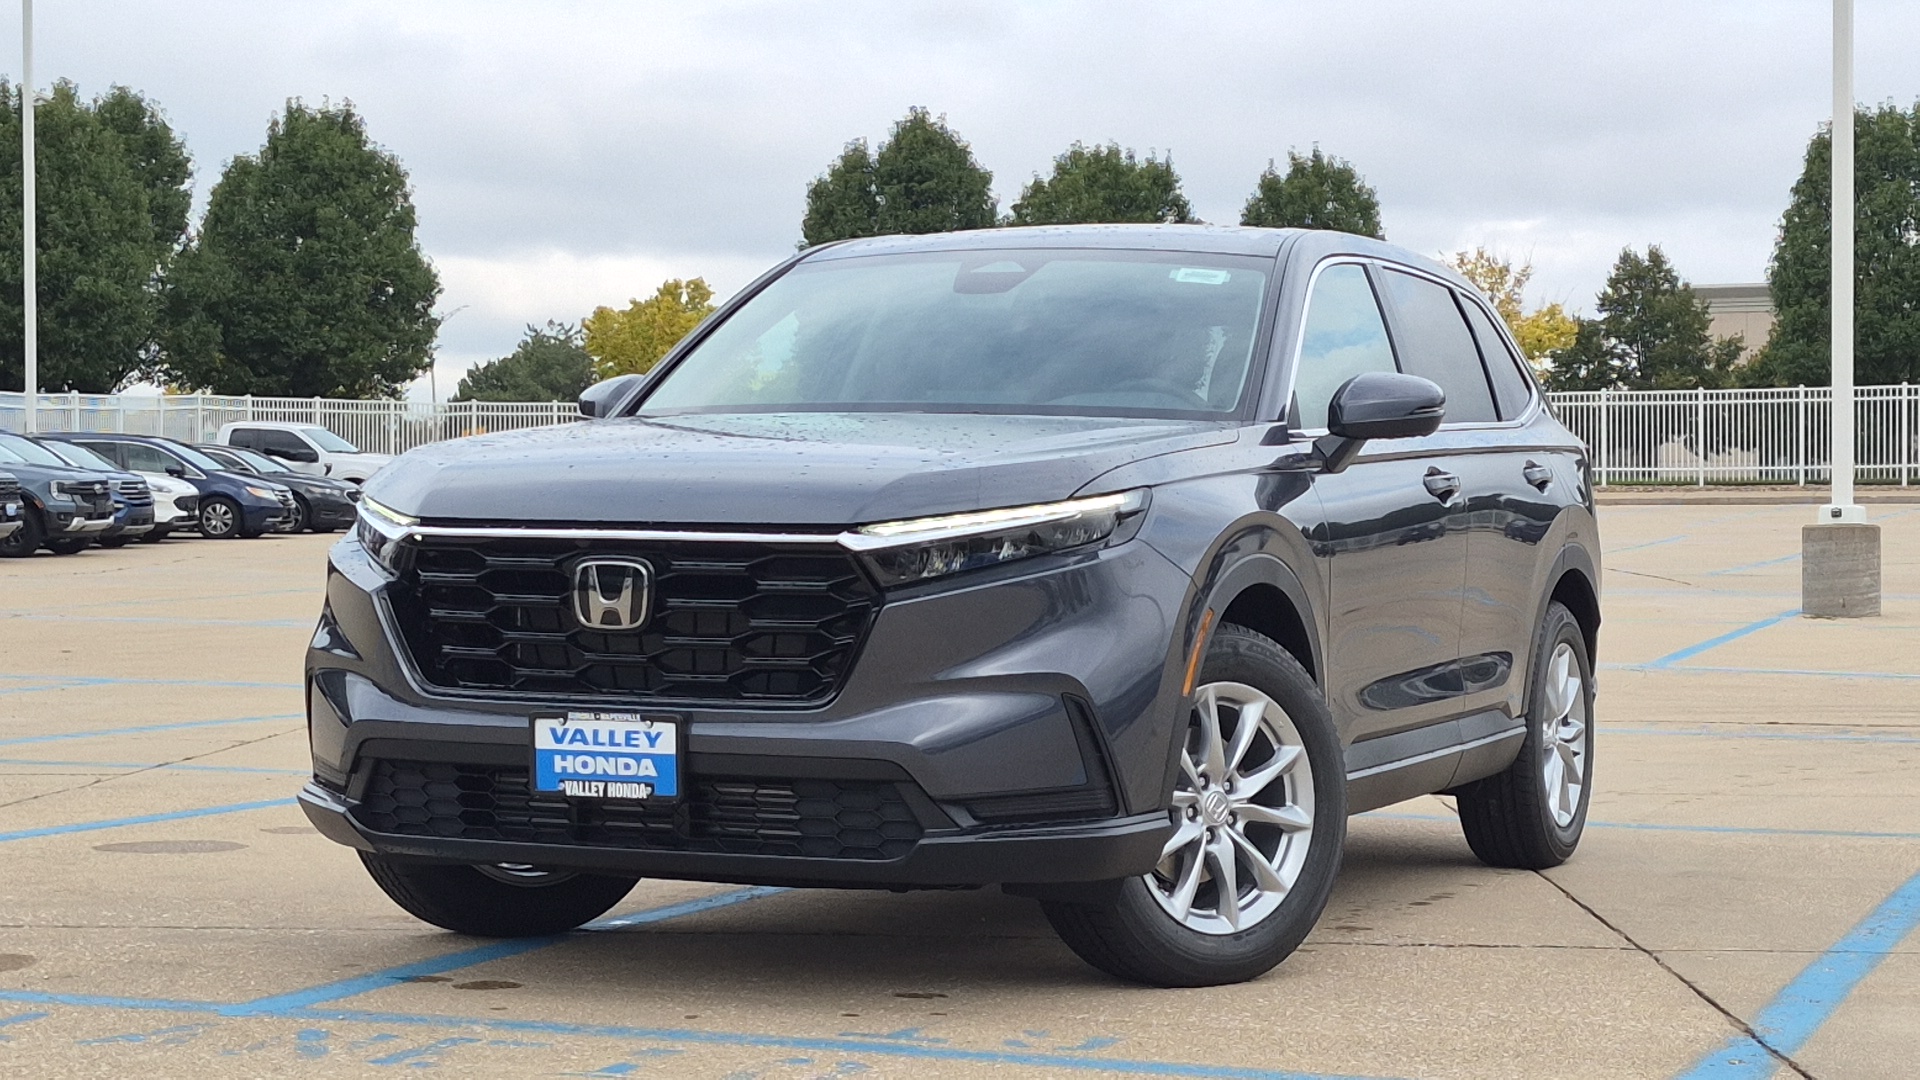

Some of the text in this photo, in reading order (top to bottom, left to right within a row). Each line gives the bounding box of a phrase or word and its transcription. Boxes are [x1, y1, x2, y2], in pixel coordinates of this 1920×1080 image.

[549, 727, 664, 749] VALLEY
[554, 754, 658, 777] HONDA
[564, 780, 647, 799] VALLEY HONDA
